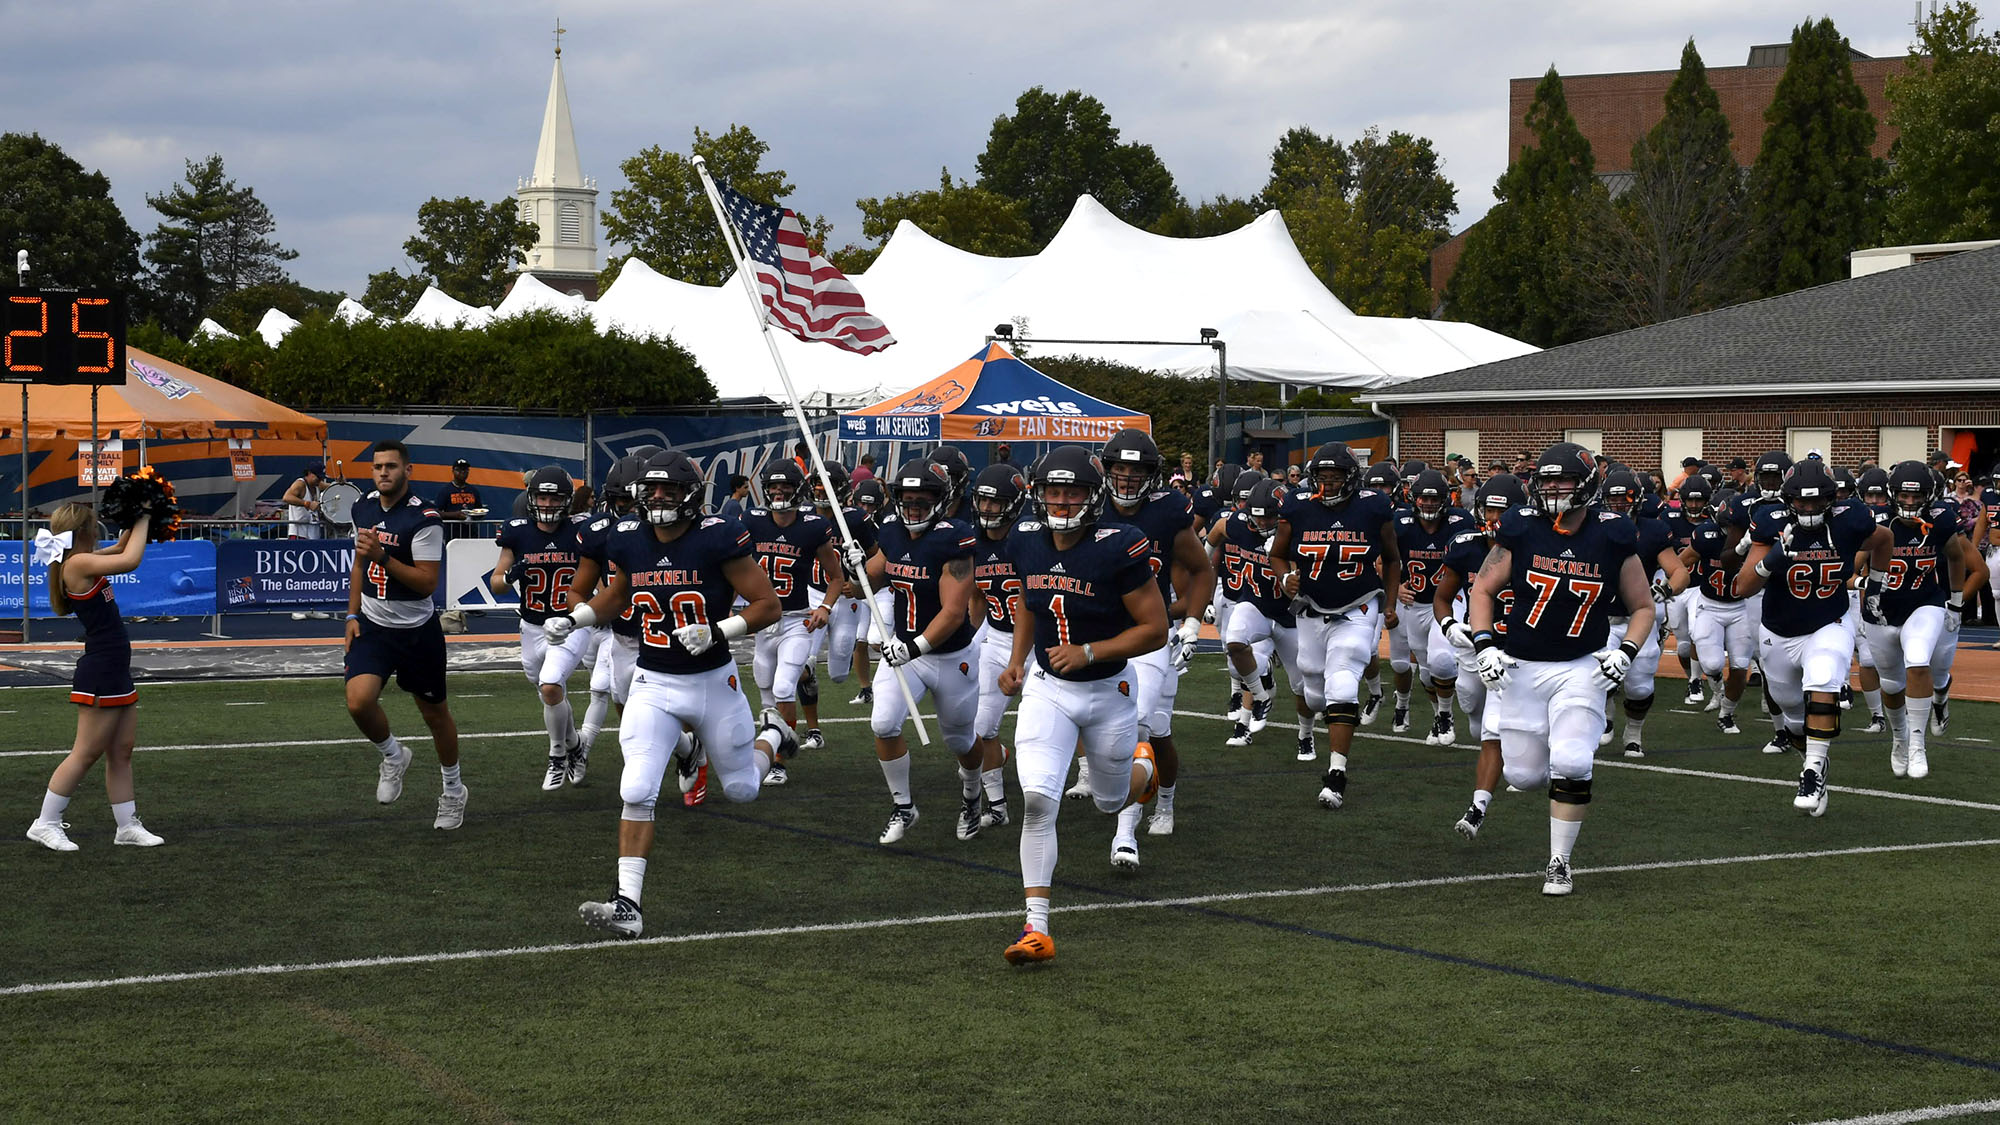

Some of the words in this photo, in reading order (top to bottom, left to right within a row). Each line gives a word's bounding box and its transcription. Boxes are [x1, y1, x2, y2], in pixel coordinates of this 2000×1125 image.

[5, 296, 114, 374] 25
[976, 396, 1082, 415] weis
[847, 417, 866, 430] weis
[876, 417, 890, 435] FAN
[892, 417, 929, 436] SERVICES
[1019, 417, 1047, 436] FAN
[1052, 418, 1126, 437] SERVICES
[1303, 530, 1368, 542] BUCKNELL
[631, 570, 703, 587] BUCKNELL
[758, 555, 796, 597] 15
[1297, 544, 1371, 580] 75
[1407, 560, 1449, 593] 64
[1533, 554, 1602, 578] BUCKNELL
[1887, 557, 1937, 590] 87
[261, 579, 282, 591] The
[286, 578, 339, 593] Gameday
[525, 567, 577, 612] 26
[1026, 574, 1095, 597] BUCKNELL
[1786, 562, 1844, 599] 65
[631, 590, 709, 649] 20
[890, 579, 917, 632] 7
[1525, 569, 1604, 637] 77
[1048, 594, 1071, 646] 1
[611, 912, 637, 921] adidas
